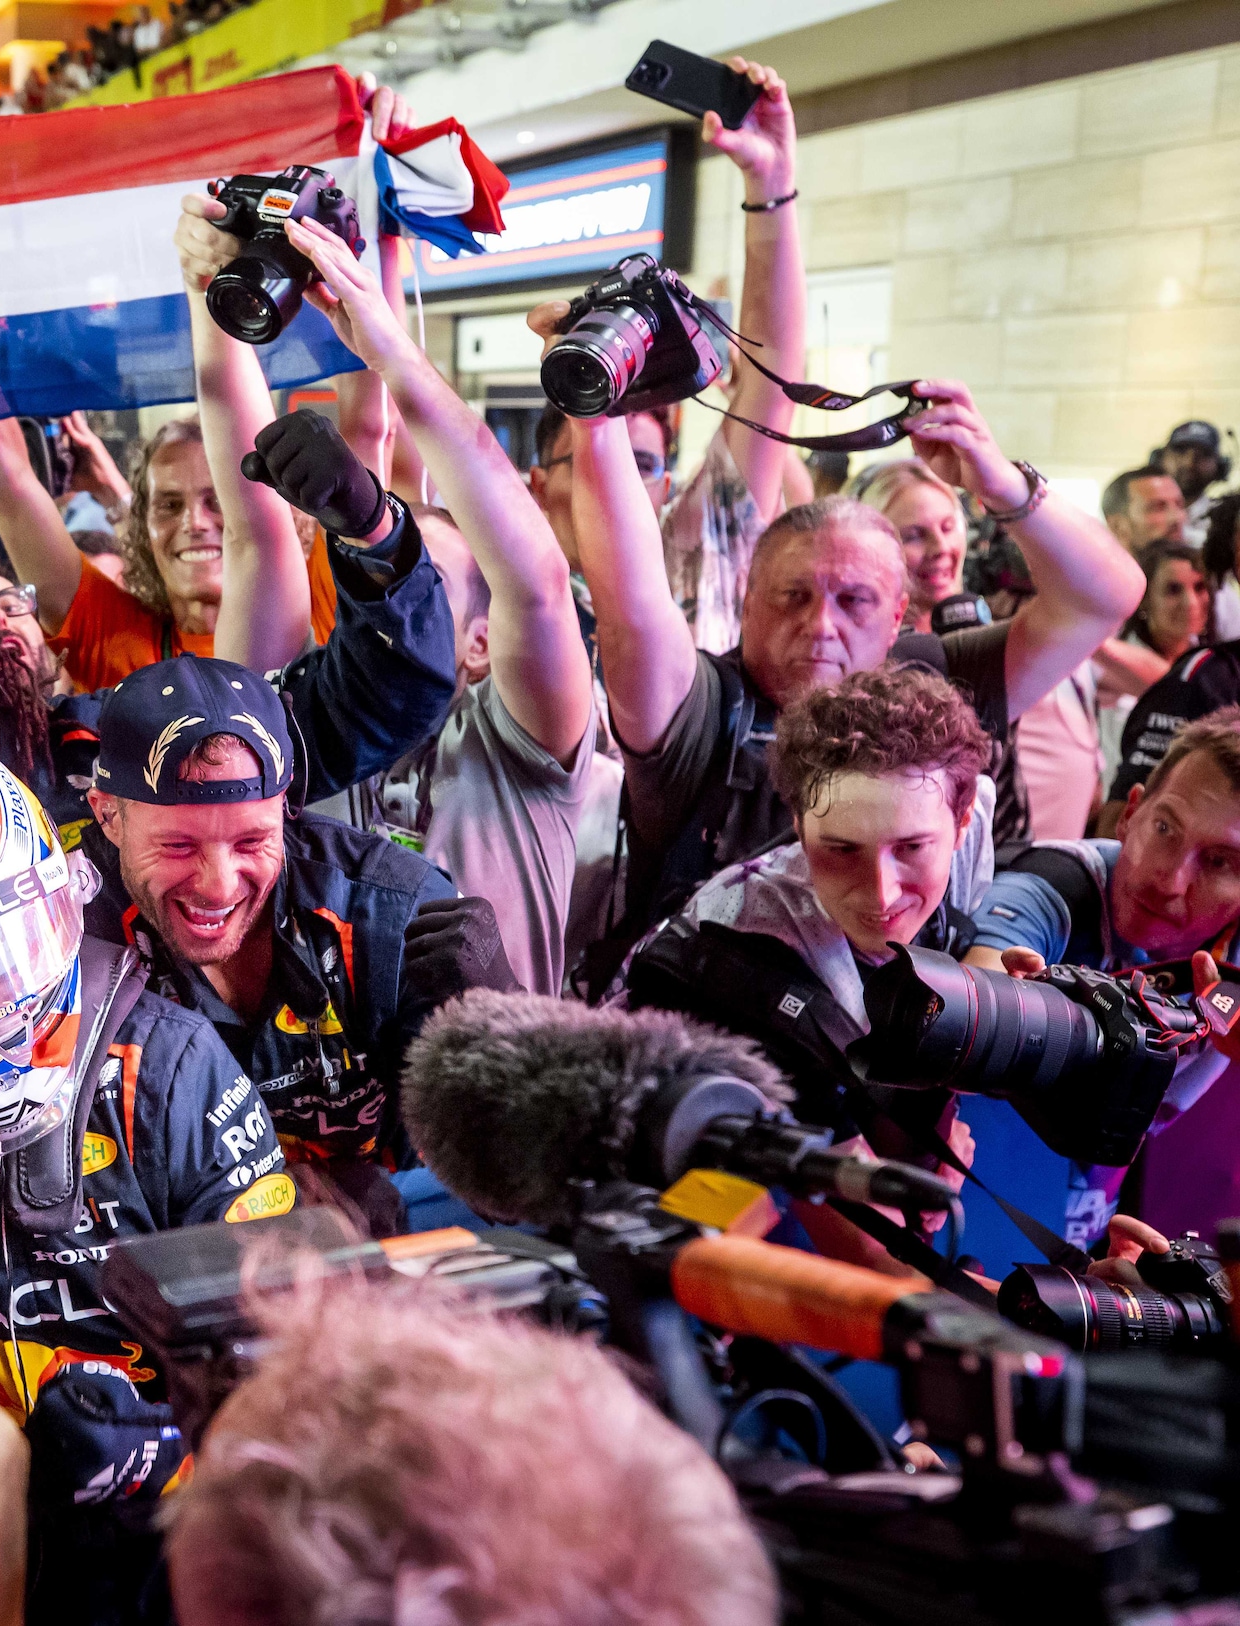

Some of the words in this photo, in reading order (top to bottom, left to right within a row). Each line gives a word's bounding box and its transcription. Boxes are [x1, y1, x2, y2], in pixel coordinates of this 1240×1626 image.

[600, 281, 623, 295] SONY
[1092, 990, 1113, 1012] Canon
[247, 1183, 290, 1216] RAUCH
[73, 1197, 120, 1235] BIT
